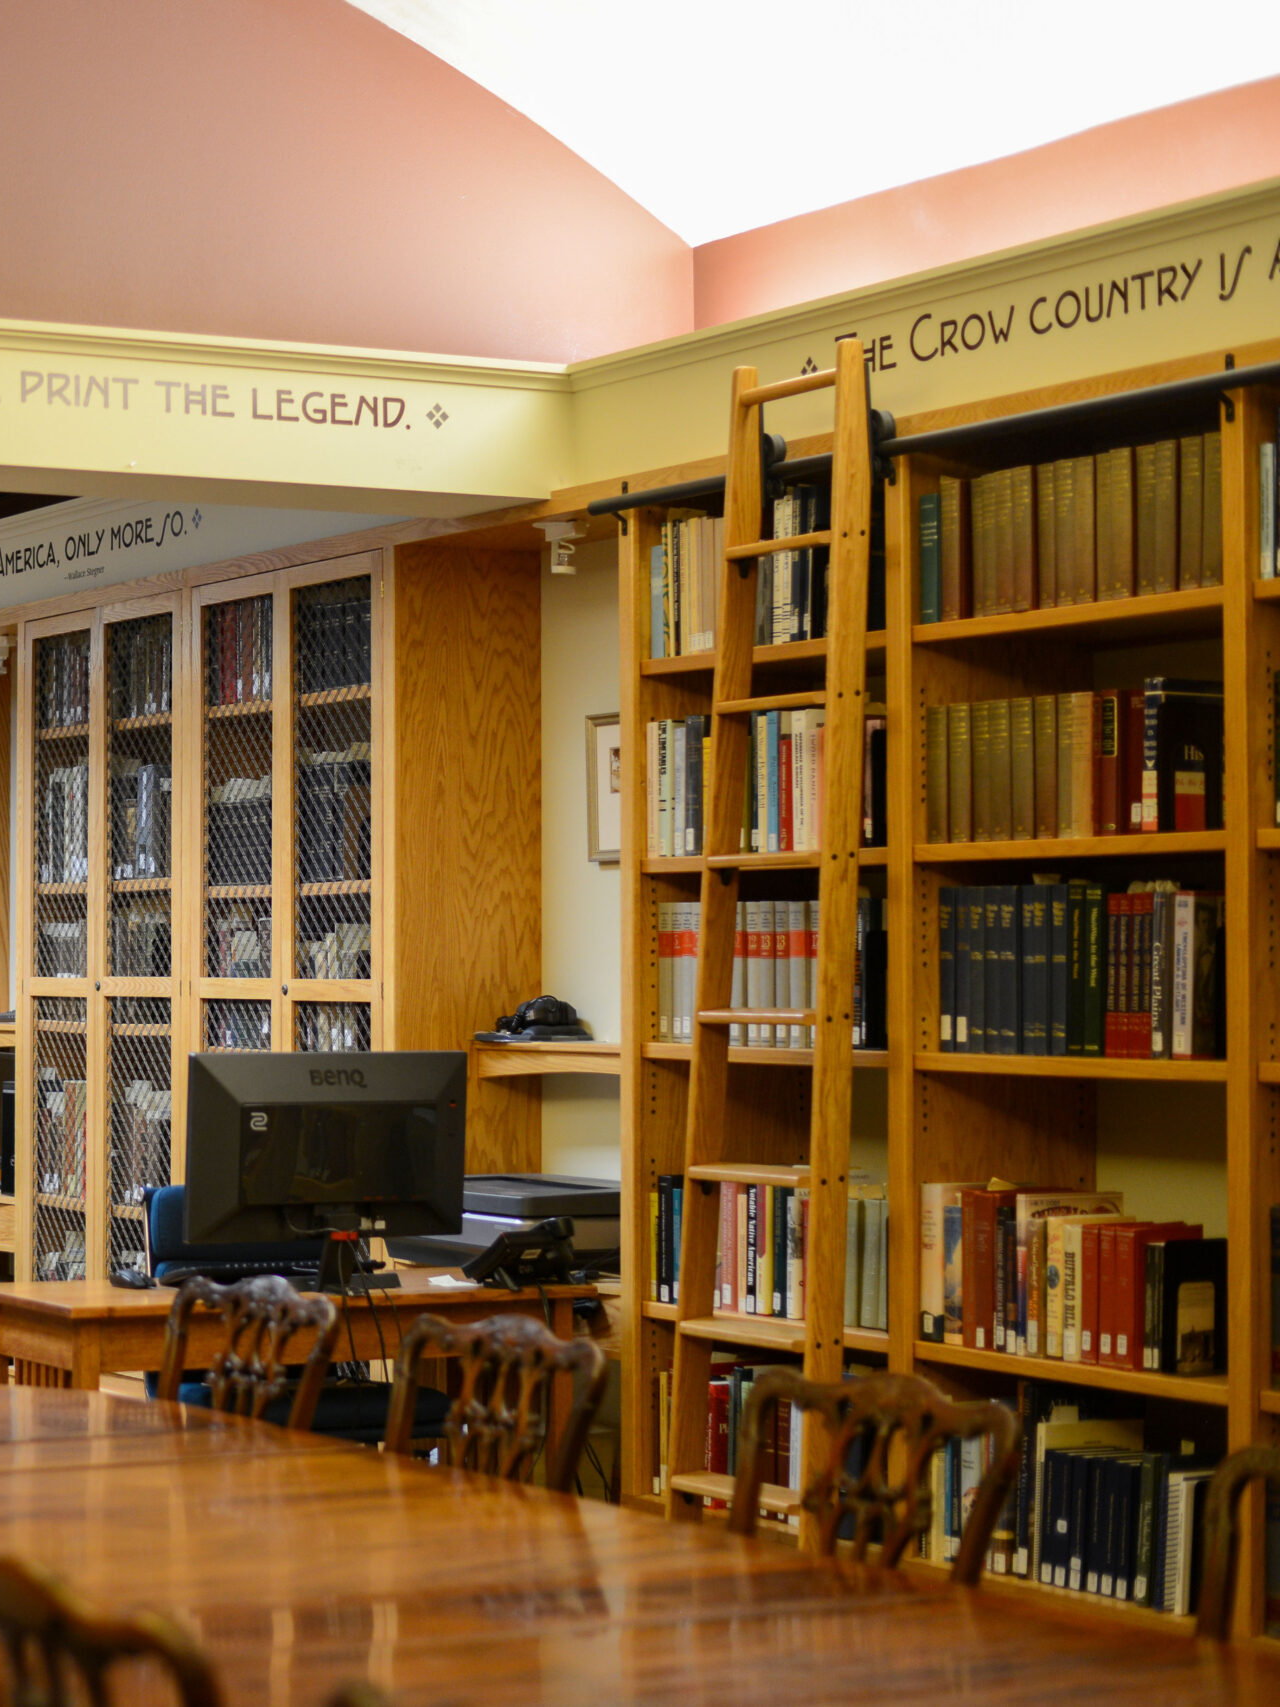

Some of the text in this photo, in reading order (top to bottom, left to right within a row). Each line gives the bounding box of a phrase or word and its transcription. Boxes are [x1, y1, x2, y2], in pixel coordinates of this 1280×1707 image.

[909, 305, 1015, 362] CROW
[1029, 258, 1203, 335] COUNTRY
[1219, 245, 1252, 302] IS
[19, 369, 140, 410] PRINT
[154, 379, 236, 418] THE
[251, 386, 413, 431] LEGEND.
[64, 528, 106, 562] ONLY
[110, 516, 155, 551] MORE
[156, 510, 188, 548] SO.
[1151, 942, 1164, 1028] Great Plains
[308, 1067, 368, 1089] BenQ
[747, 1187, 758, 1287] Notable Native Americans
[1063, 1251, 1076, 1330] BUFFALO BILL
